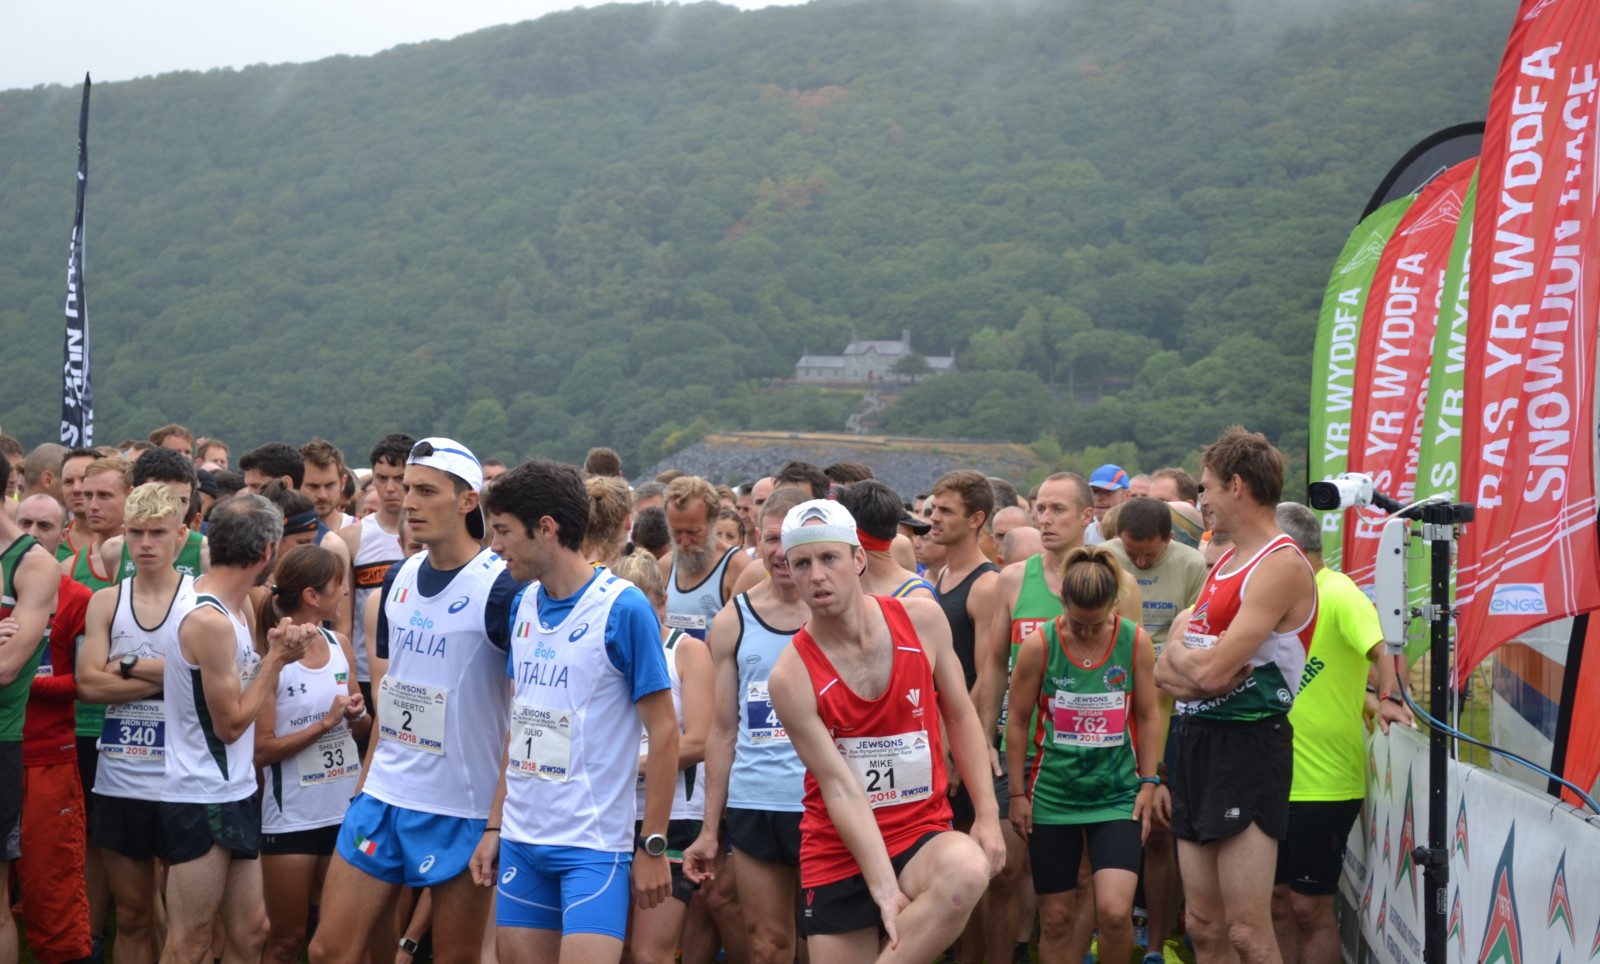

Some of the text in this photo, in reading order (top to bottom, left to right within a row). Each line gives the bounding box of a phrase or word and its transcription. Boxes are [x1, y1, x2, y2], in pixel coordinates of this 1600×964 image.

[1492, 41, 1562, 285] WYDDFA
[1373, 252, 1428, 398] WYDDFA
[1326, 287, 1361, 412] WYDDFA
[1485, 304, 1532, 378] YR
[1325, 422, 1351, 462] YR
[1366, 410, 1405, 456] YR
[392, 626, 446, 659] ITALIA
[518, 662, 568, 689] ITALIA
[394, 682, 427, 695] JEWSONS
[393, 699, 425, 713] ALBERTO
[401, 710, 412, 732] 2
[1072, 717, 1107, 733] 762
[119, 726, 156, 746] 340
[398, 731, 417, 743] 2018
[419, 738, 442, 748] JEWSON
[856, 739, 903, 749] JEWSONS
[1080, 734, 1101, 742] 2018
[126, 747, 147, 755] 2018
[525, 736, 532, 759] 1
[323, 748, 345, 769] 33
[521, 761, 537, 771] 2018
[539, 765, 566, 774] JEWSON
[869, 760, 893, 768] MIKE
[327, 767, 345, 778] 2018
[865, 768, 895, 792] 21
[870, 786, 929, 803] 2018 JEWSON
